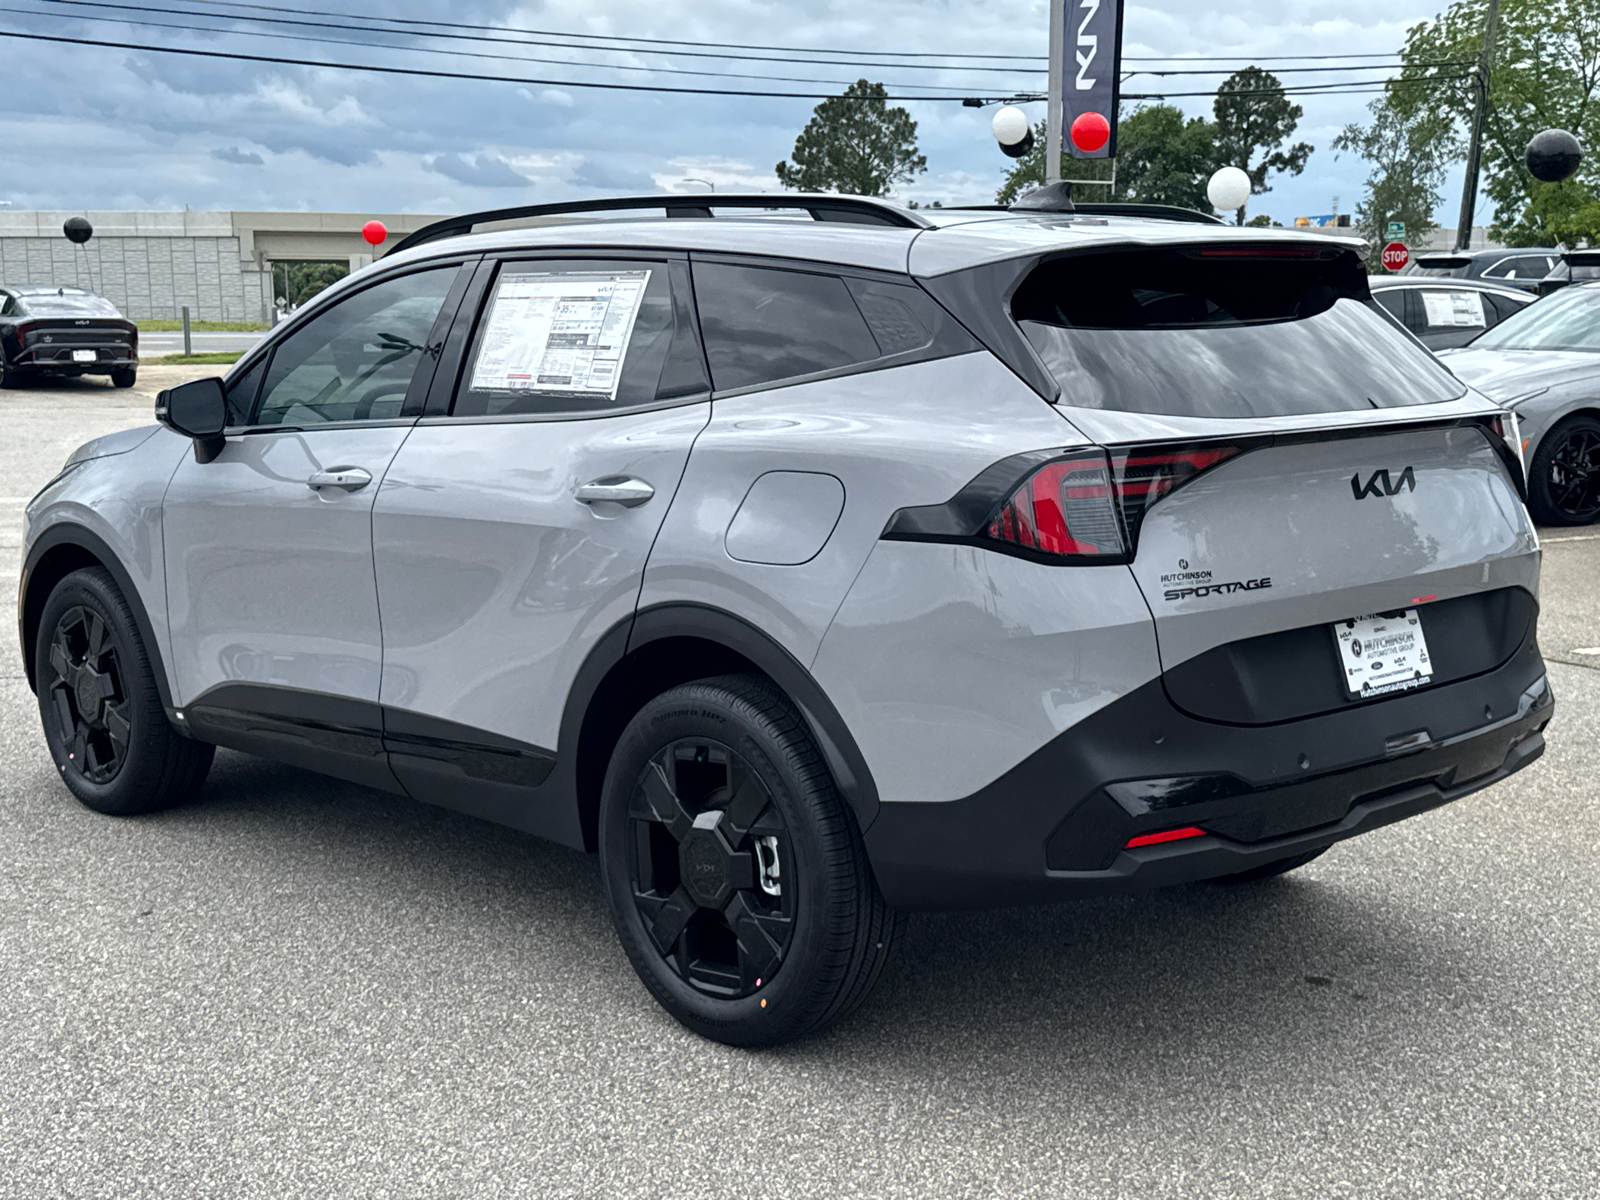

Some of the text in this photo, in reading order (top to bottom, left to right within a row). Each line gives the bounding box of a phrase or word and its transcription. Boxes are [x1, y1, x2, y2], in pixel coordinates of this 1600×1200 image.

[1383, 251, 1408, 262] STOP
[1351, 466, 1416, 500] KIA
[1161, 571, 1212, 582] HUTCHINSON
[1164, 577, 1272, 601] SPORTAGE
[1340, 631, 1352, 639] KIA
[1364, 631, 1415, 652] HUTCHINSON
[1367, 643, 1415, 660] AUTOMOTIVE GROUP
[1394, 656, 1406, 664] KIA
